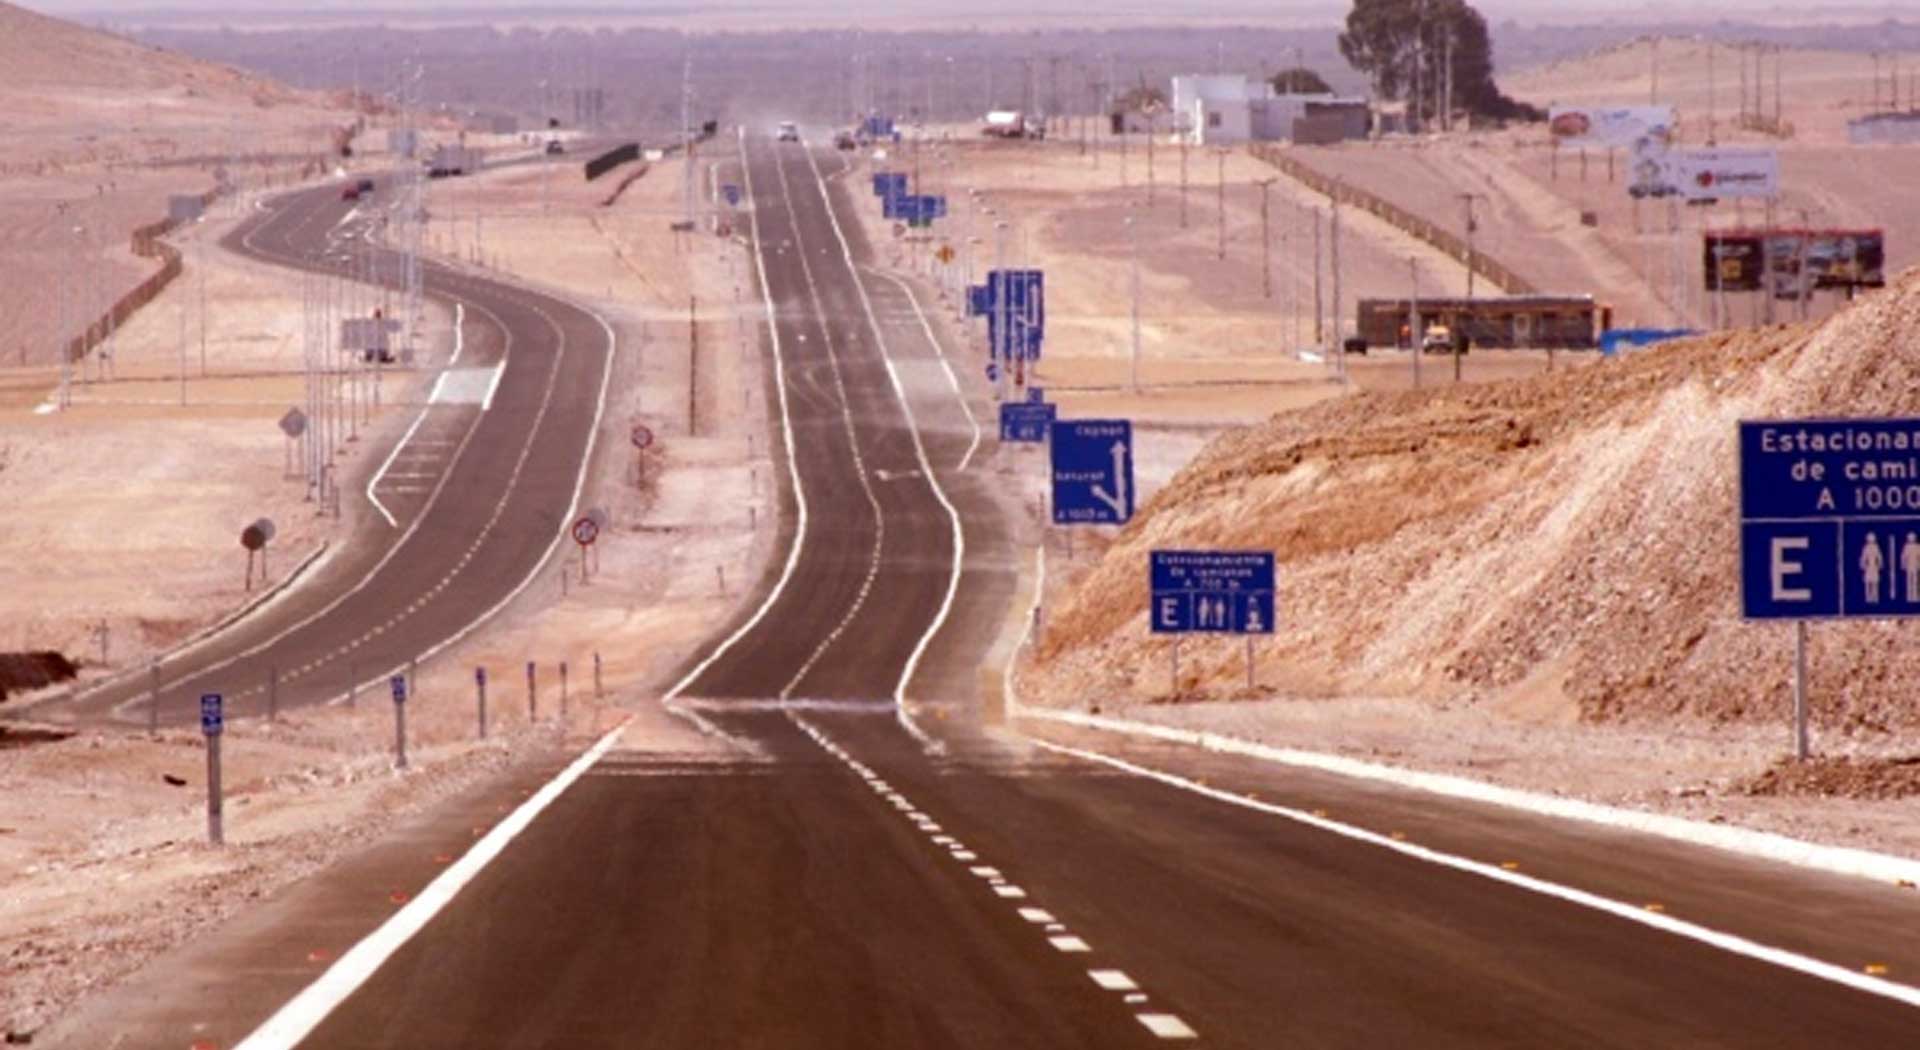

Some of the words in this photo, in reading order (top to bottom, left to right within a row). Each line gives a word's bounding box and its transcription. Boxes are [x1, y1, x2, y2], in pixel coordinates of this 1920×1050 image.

[1791, 458, 1825, 481] de
[1816, 486, 1835, 510] A
[1855, 484, 1920, 509] 1000
[1771, 537, 1812, 601] E
[1161, 597, 1179, 627] E
